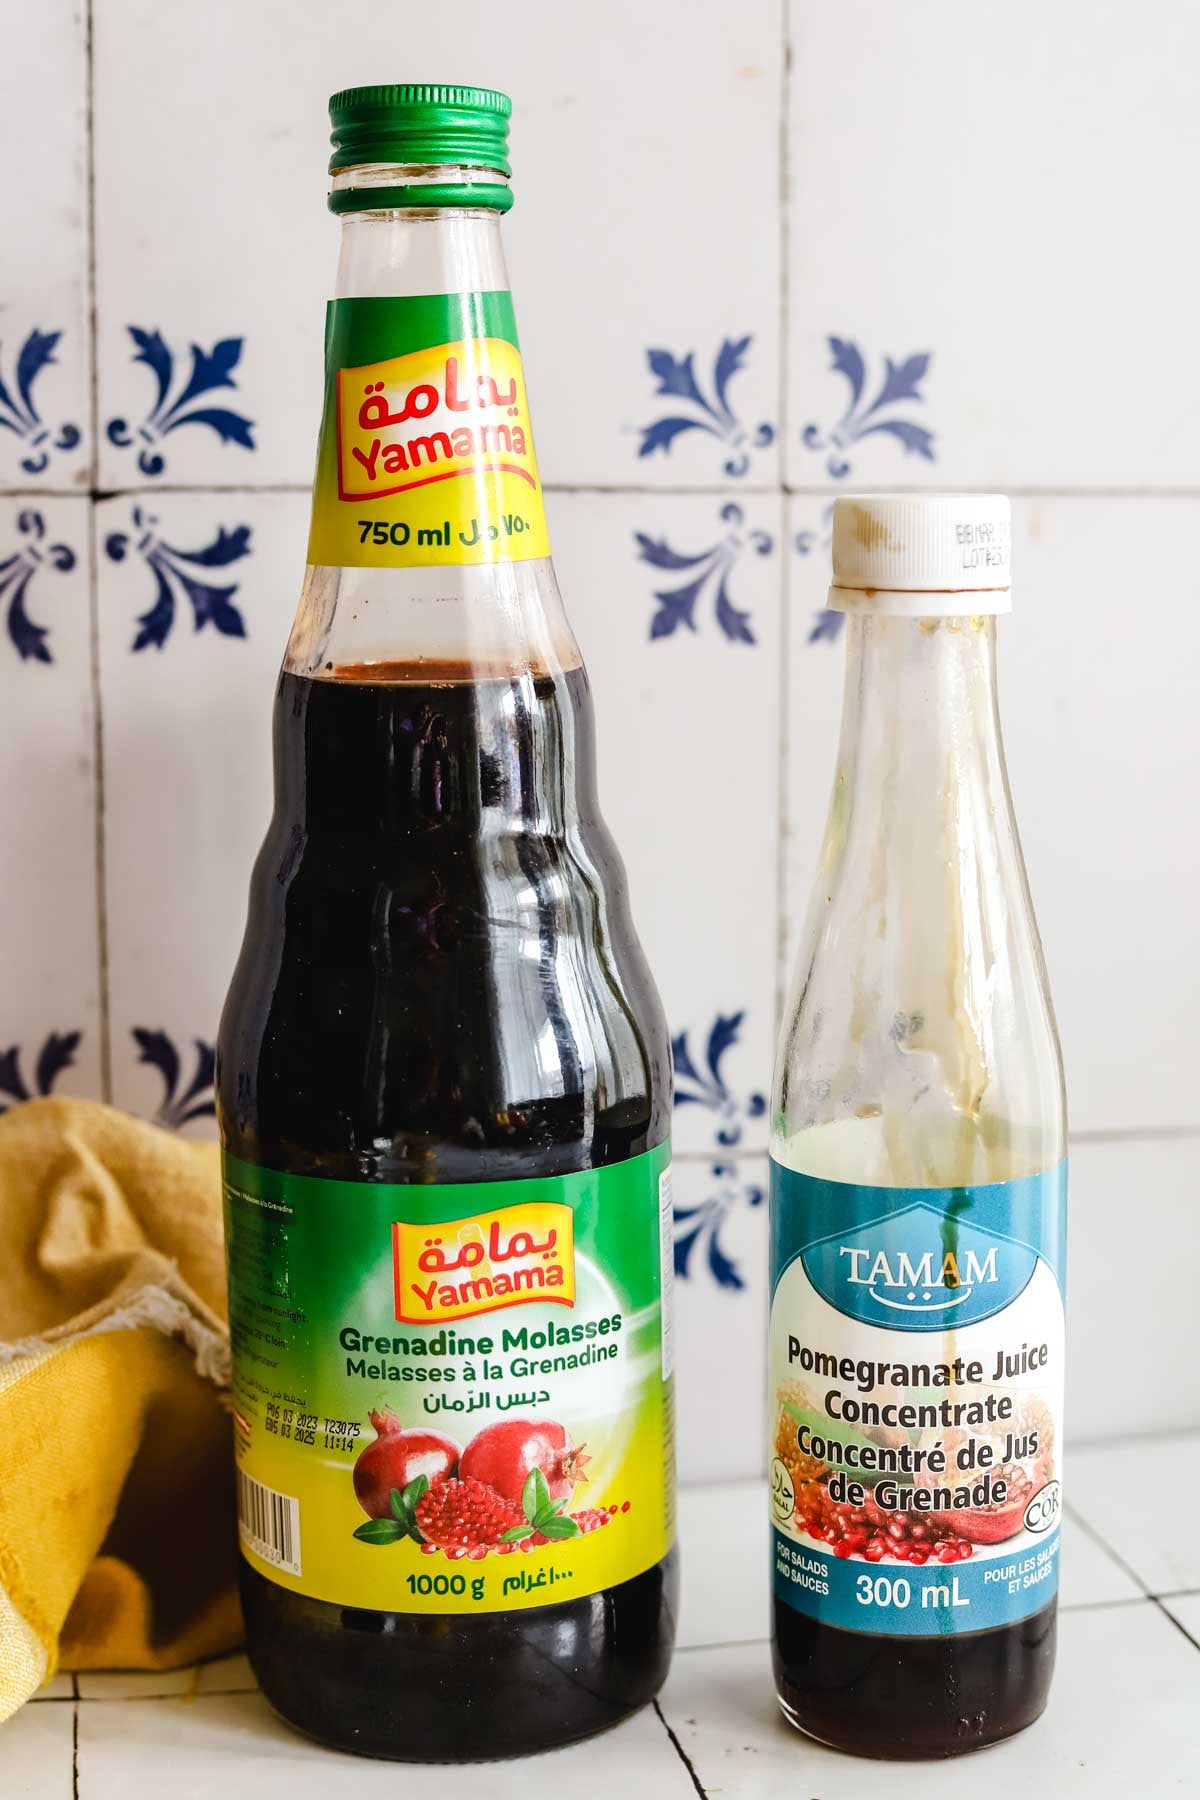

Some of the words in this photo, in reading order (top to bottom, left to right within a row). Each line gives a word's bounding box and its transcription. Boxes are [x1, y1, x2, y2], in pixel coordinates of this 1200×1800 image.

[352, 423, 526, 480] Yamama
[357, 520, 410, 545] 750
[417, 521, 450, 546] ml
[418, 1221, 557, 1273] يمامة
[840, 1246, 998, 1288] TAMAM
[411, 1263, 564, 1310] Yamama
[339, 1327, 493, 1355] Grenadine
[502, 1313, 623, 1353] Molasses
[346, 1358, 455, 1381] Melasses
[463, 1360, 476, 1380] à
[484, 1360, 503, 1380] la
[510, 1343, 618, 1377] Grenadine
[788, 1335, 983, 1392] Pomegranate
[992, 1343, 1048, 1381] Juice
[496, 1389, 551, 1410] دبس
[824, 1390, 1012, 1428] Concentrate
[281, 1422, 291, 1439] 03
[294, 1428, 316, 1446] 2025
[324, 1435, 354, 1452] 11:14
[283, 1408, 293, 1423] 03
[297, 1413, 318, 1430] 2023
[324, 1418, 361, 1437] T23075
[797, 1425, 946, 1472] Concentré
[956, 1438, 993, 1470] de
[1002, 1430, 1038, 1463] Jus
[829, 1472, 864, 1507] de
[875, 1477, 1008, 1510] Grenade
[1026, 1488, 1059, 1527] COR
[777, 1541, 790, 1560] FOR
[791, 1552, 828, 1577] SALADS
[777, 1559, 790, 1577] AND
[791, 1569, 829, 1595] SAUCES
[984, 1565, 1016, 1584] POUR
[1019, 1557, 1035, 1575] LES
[1008, 1579, 1021, 1594] ET
[1023, 1561, 1052, 1588] SAUCES
[406, 1574, 466, 1595] 1000
[471, 1576, 485, 1600] g
[503, 1568, 546, 1596] غرام
[856, 1575, 911, 1607] 300
[921, 1577, 969, 1608] mL
